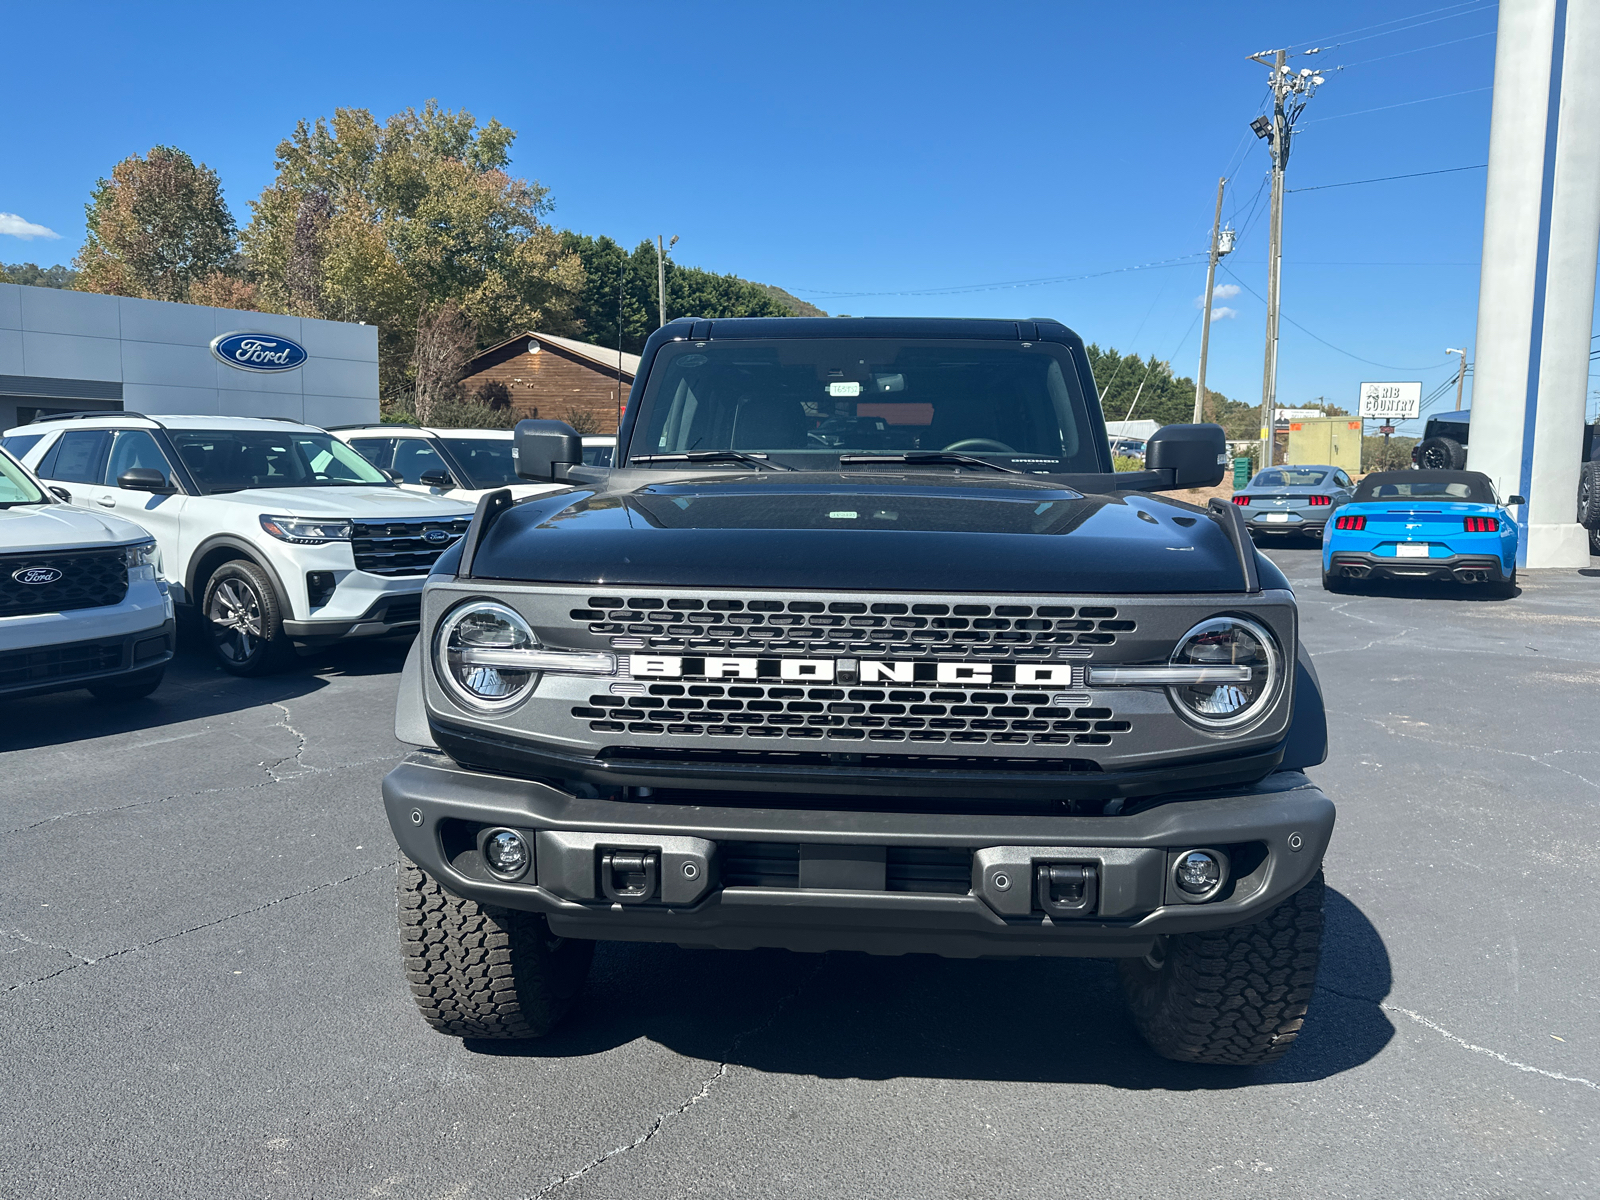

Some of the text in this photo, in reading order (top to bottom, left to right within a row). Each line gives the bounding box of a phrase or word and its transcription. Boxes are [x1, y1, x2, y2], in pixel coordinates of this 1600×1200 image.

[235, 339, 291, 364] Ford
[1381, 386, 1400, 399] RIB
[1364, 399, 1415, 412] COUNTRY
[429, 532, 445, 540] Ford
[24, 569, 54, 582] Ford
[629, 653, 1072, 686] BRONCO
